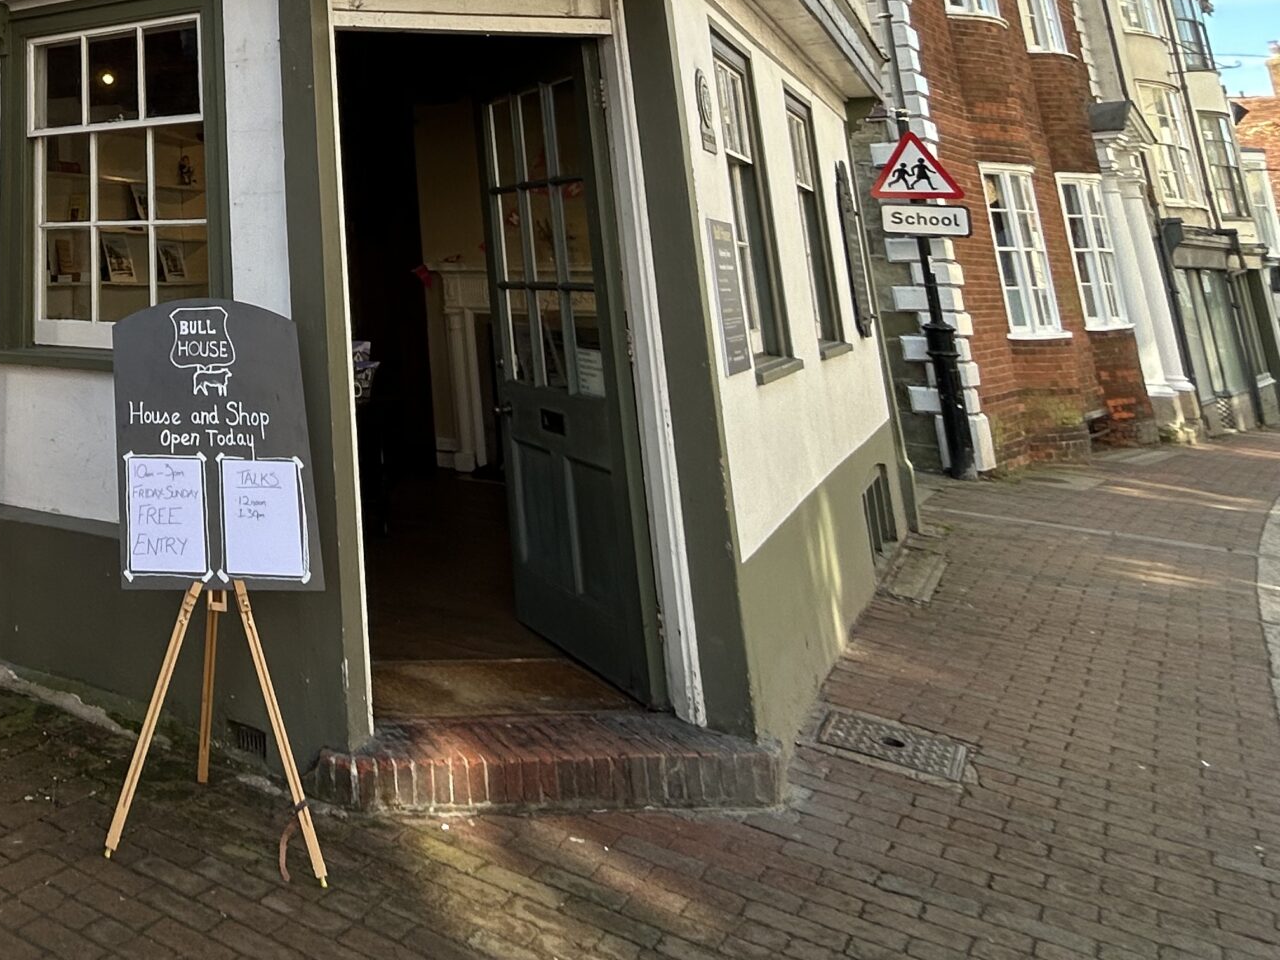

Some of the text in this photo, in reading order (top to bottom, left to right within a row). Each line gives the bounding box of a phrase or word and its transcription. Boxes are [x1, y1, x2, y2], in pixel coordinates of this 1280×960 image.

[891, 211, 960, 227] School
[179, 320, 216, 335] BULL
[177, 340, 228, 358] HOUSE
[128, 401, 270, 440] House and Shop
[160, 429, 256, 461] Open Today
[236, 469, 280, 487] TALKS
[138, 504, 184, 525] FREE
[133, 533, 188, 557] ENTRY
